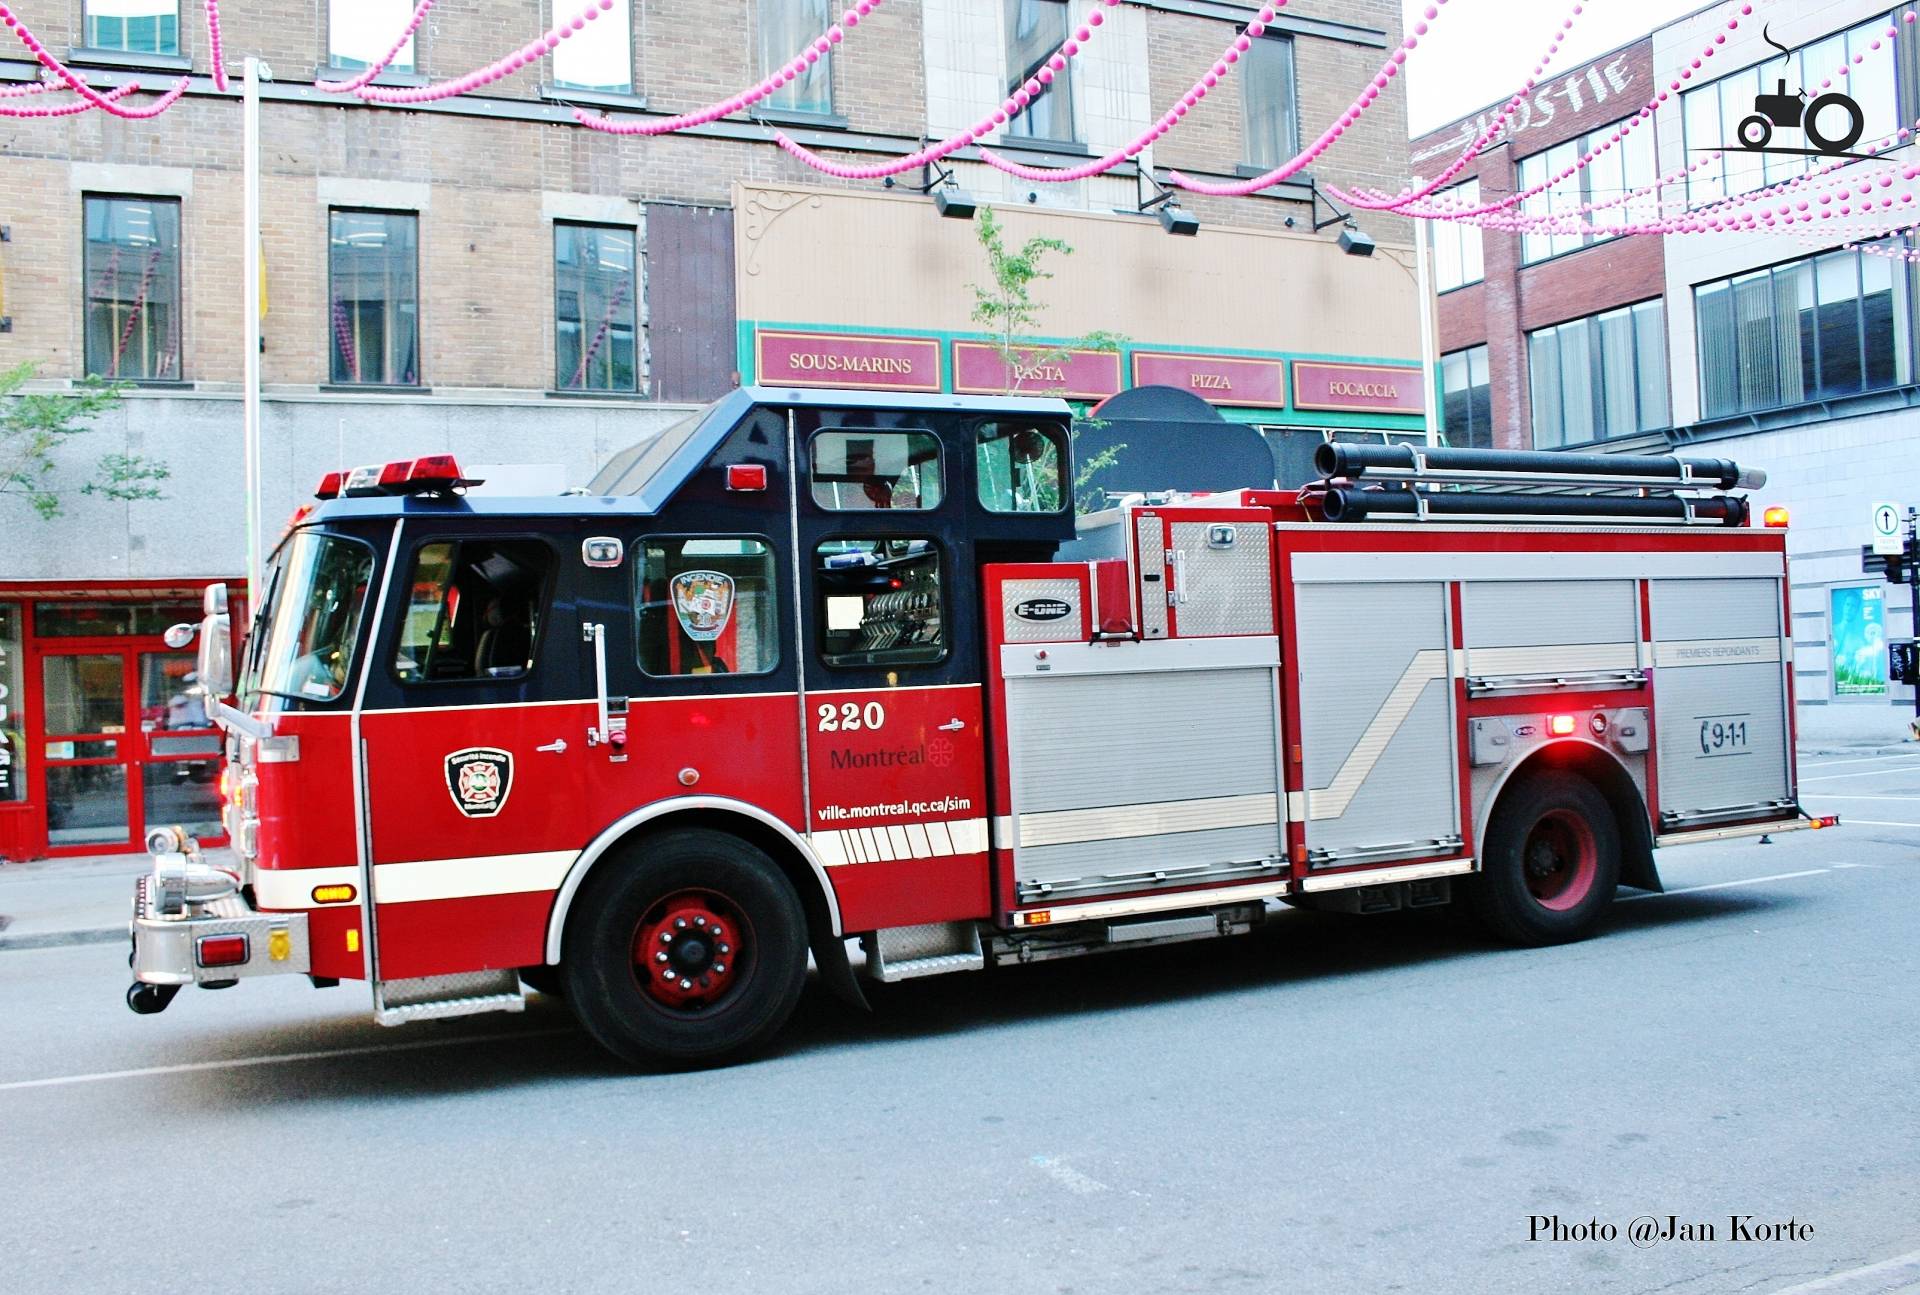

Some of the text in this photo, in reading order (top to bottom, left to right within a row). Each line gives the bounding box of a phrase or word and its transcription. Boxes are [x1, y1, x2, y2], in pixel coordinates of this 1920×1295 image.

[789, 353, 912, 374] SOUS-MARINS
[1013, 364, 1066, 382] PASTA
[1190, 373, 1232, 390] PIZZA
[1329, 381, 1398, 399] FOCACCIA
[1018, 603, 1067, 616] E-ONE
[818, 701, 885, 732] 220
[831, 744, 926, 769] Montréal
[818, 795, 971, 821] ville.montreal.qc.ca/sim
